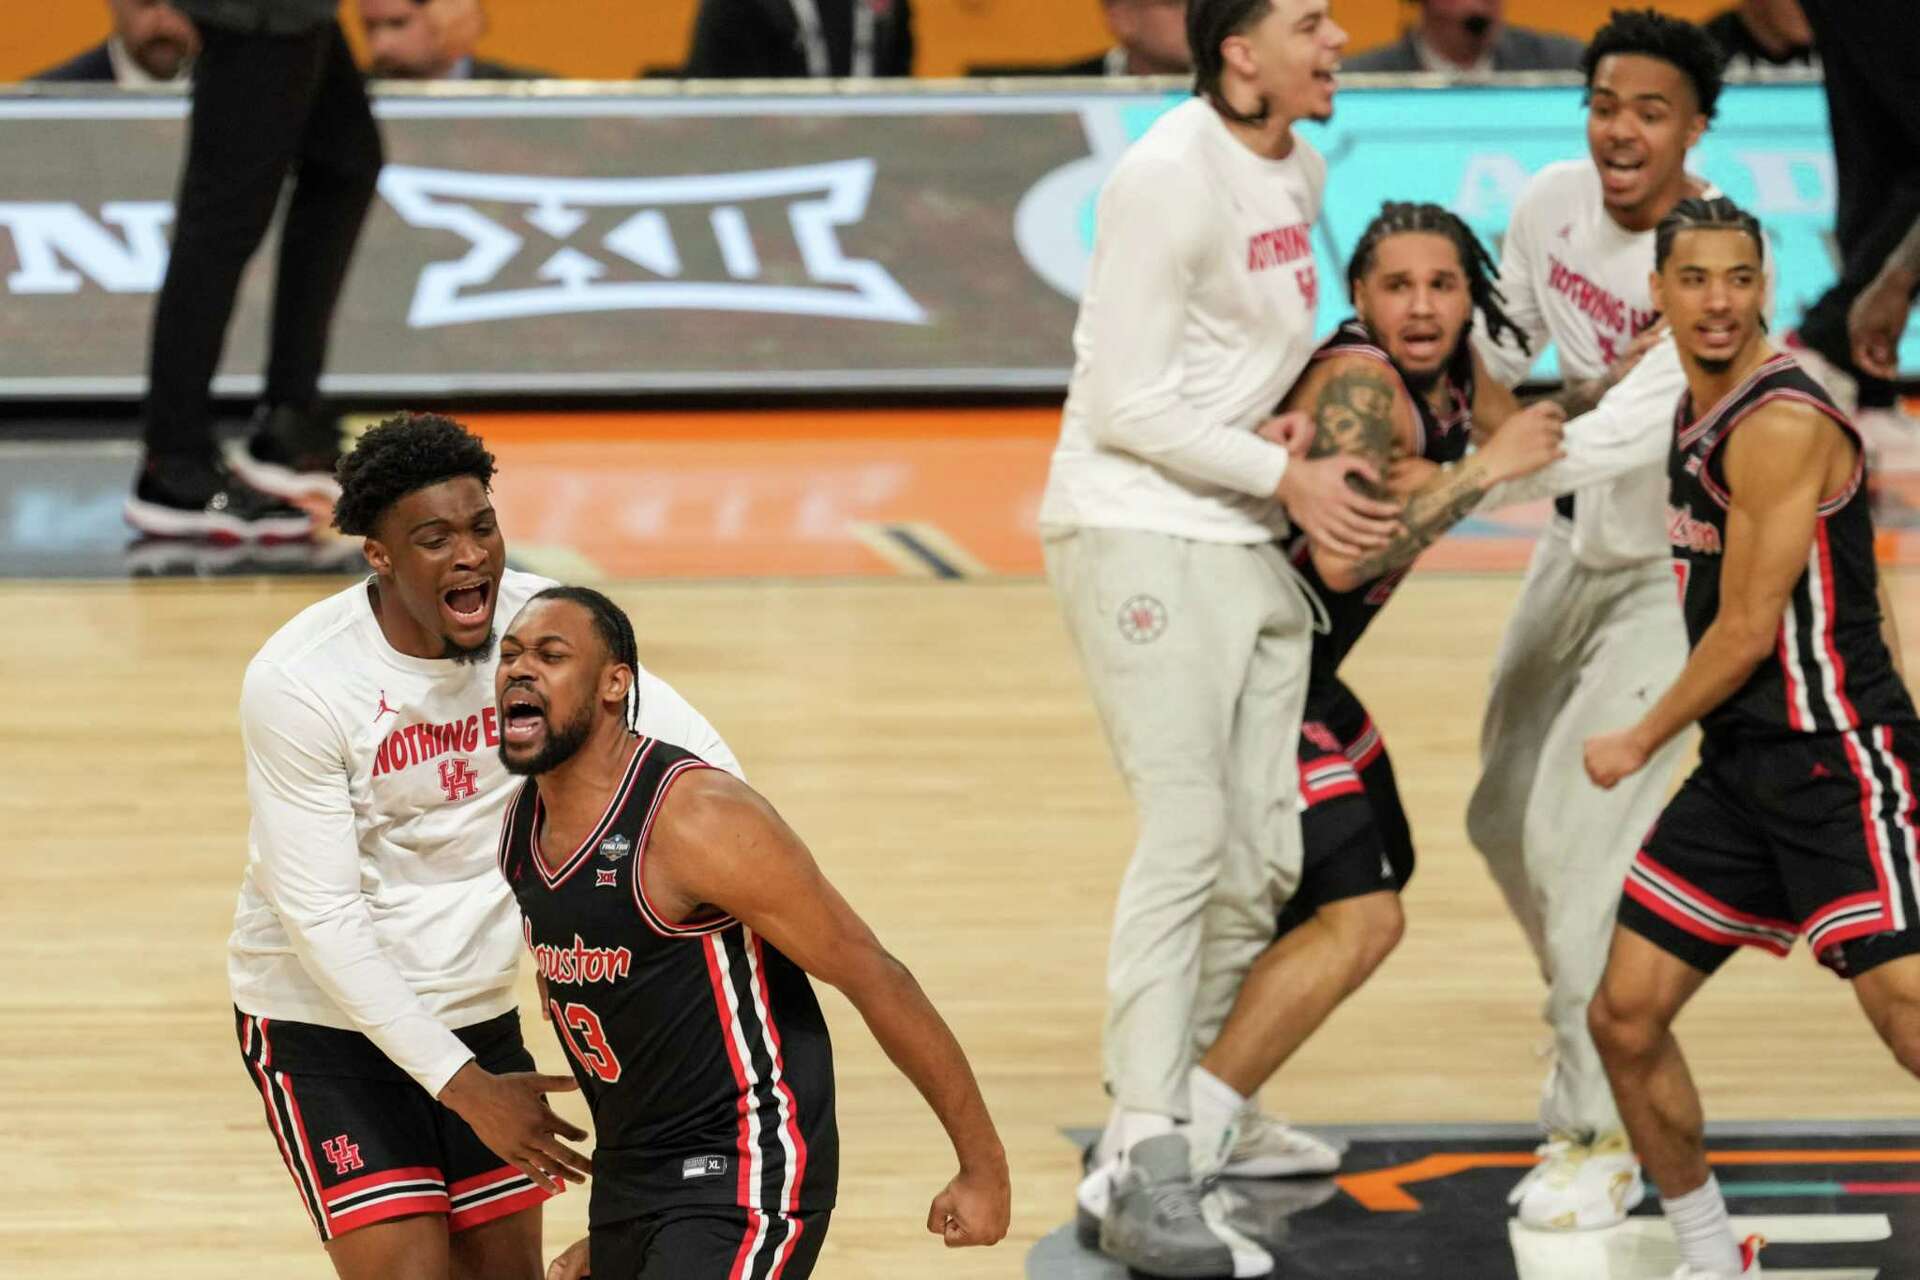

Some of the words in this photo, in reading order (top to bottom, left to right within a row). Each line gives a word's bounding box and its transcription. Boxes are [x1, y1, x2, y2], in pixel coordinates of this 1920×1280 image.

[372, 714, 479, 777] NOTHING
[550, 998, 622, 1083] 13
[708, 1160, 720, 1169] XL
